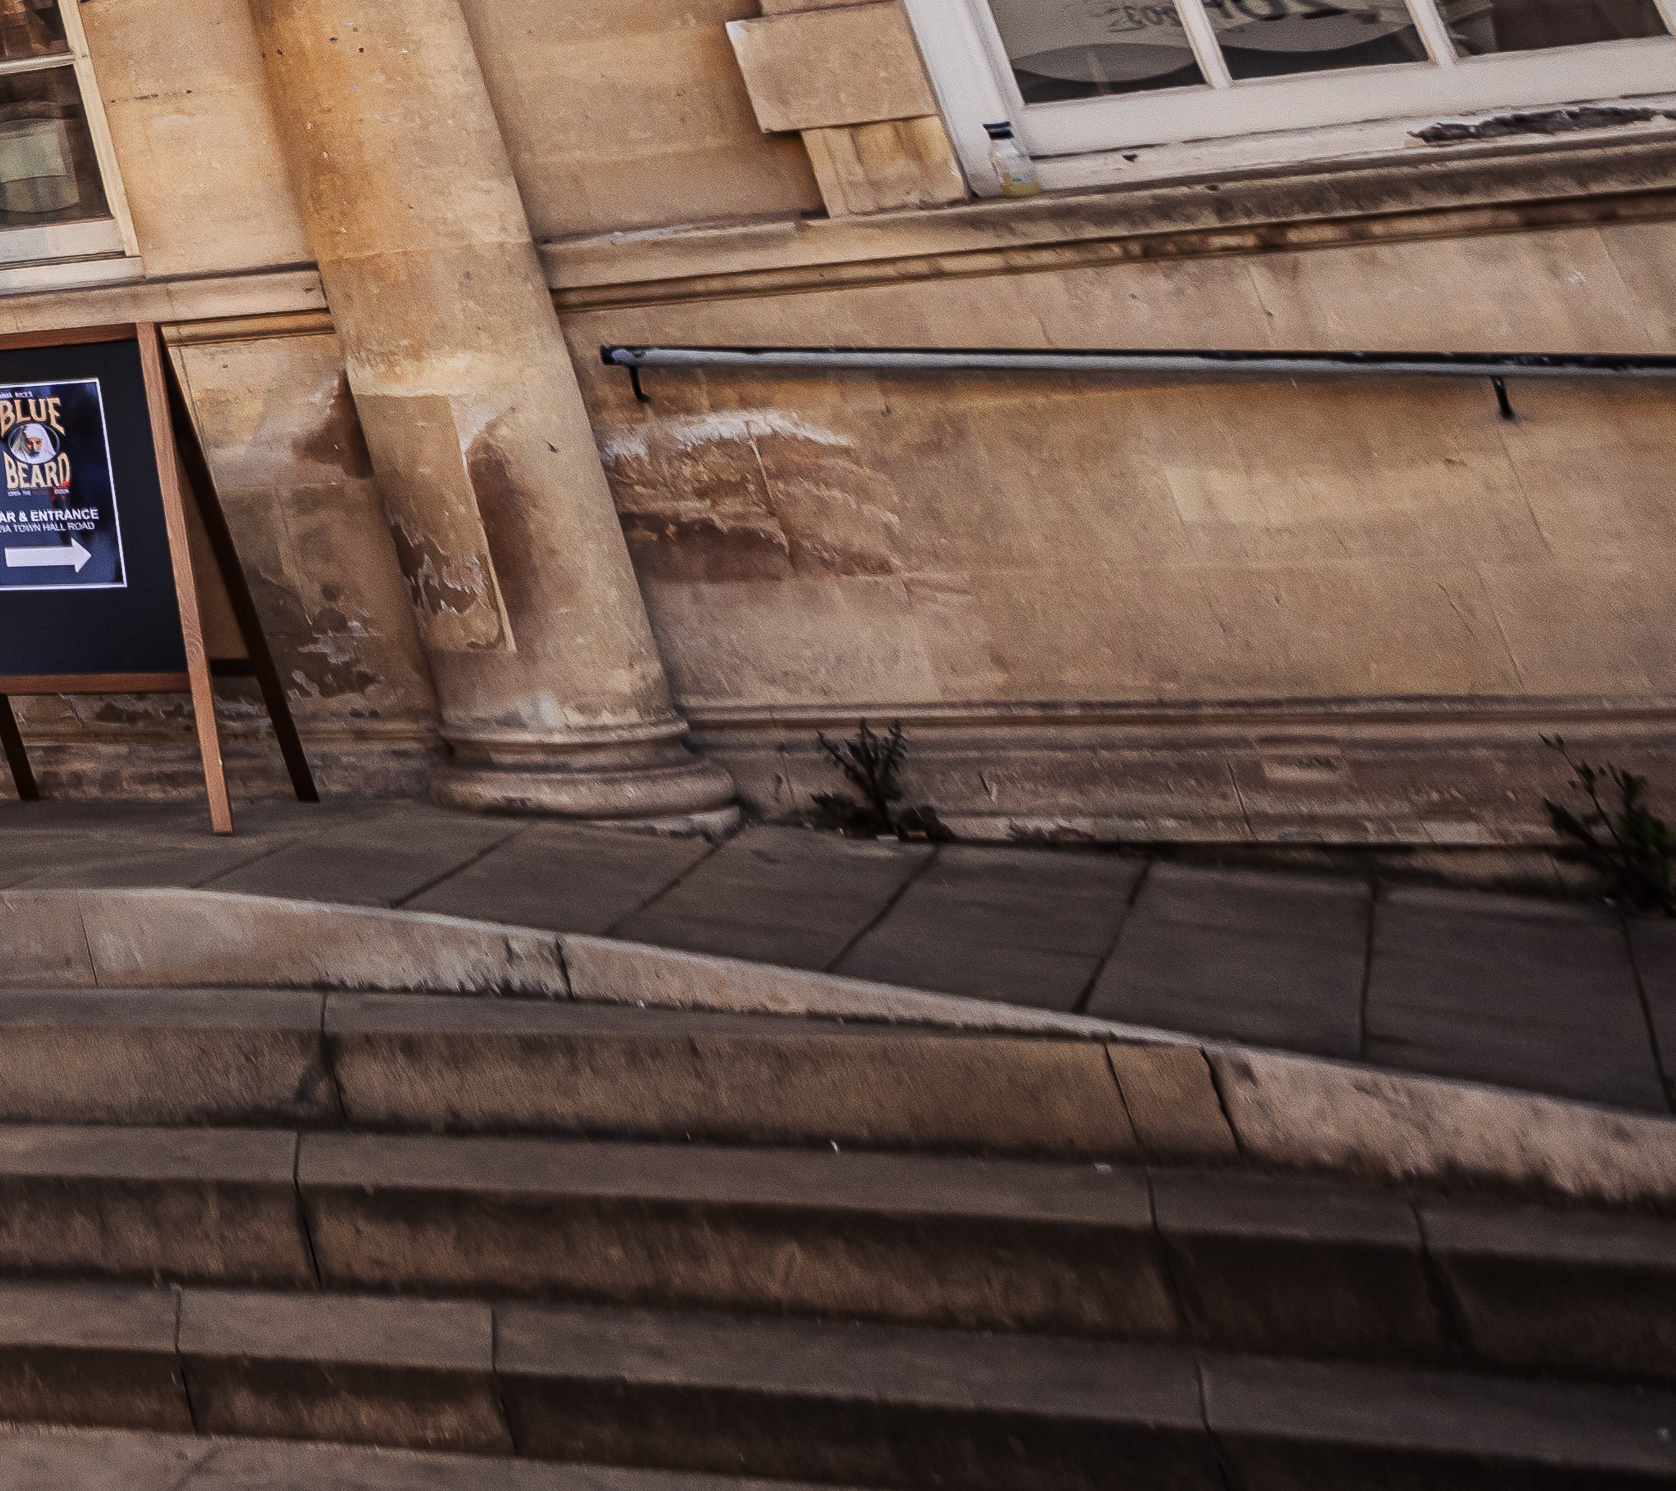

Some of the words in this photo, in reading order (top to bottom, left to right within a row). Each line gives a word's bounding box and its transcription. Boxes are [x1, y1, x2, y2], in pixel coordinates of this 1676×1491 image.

[3, 450, 71, 489] BEARD
[19, 510, 28, 522] &
[31, 507, 100, 522] ENTRANCE
[13, 523, 41, 533] TOWN
[43, 522, 66, 531] HALL
[68, 521, 95, 530] ROAD
